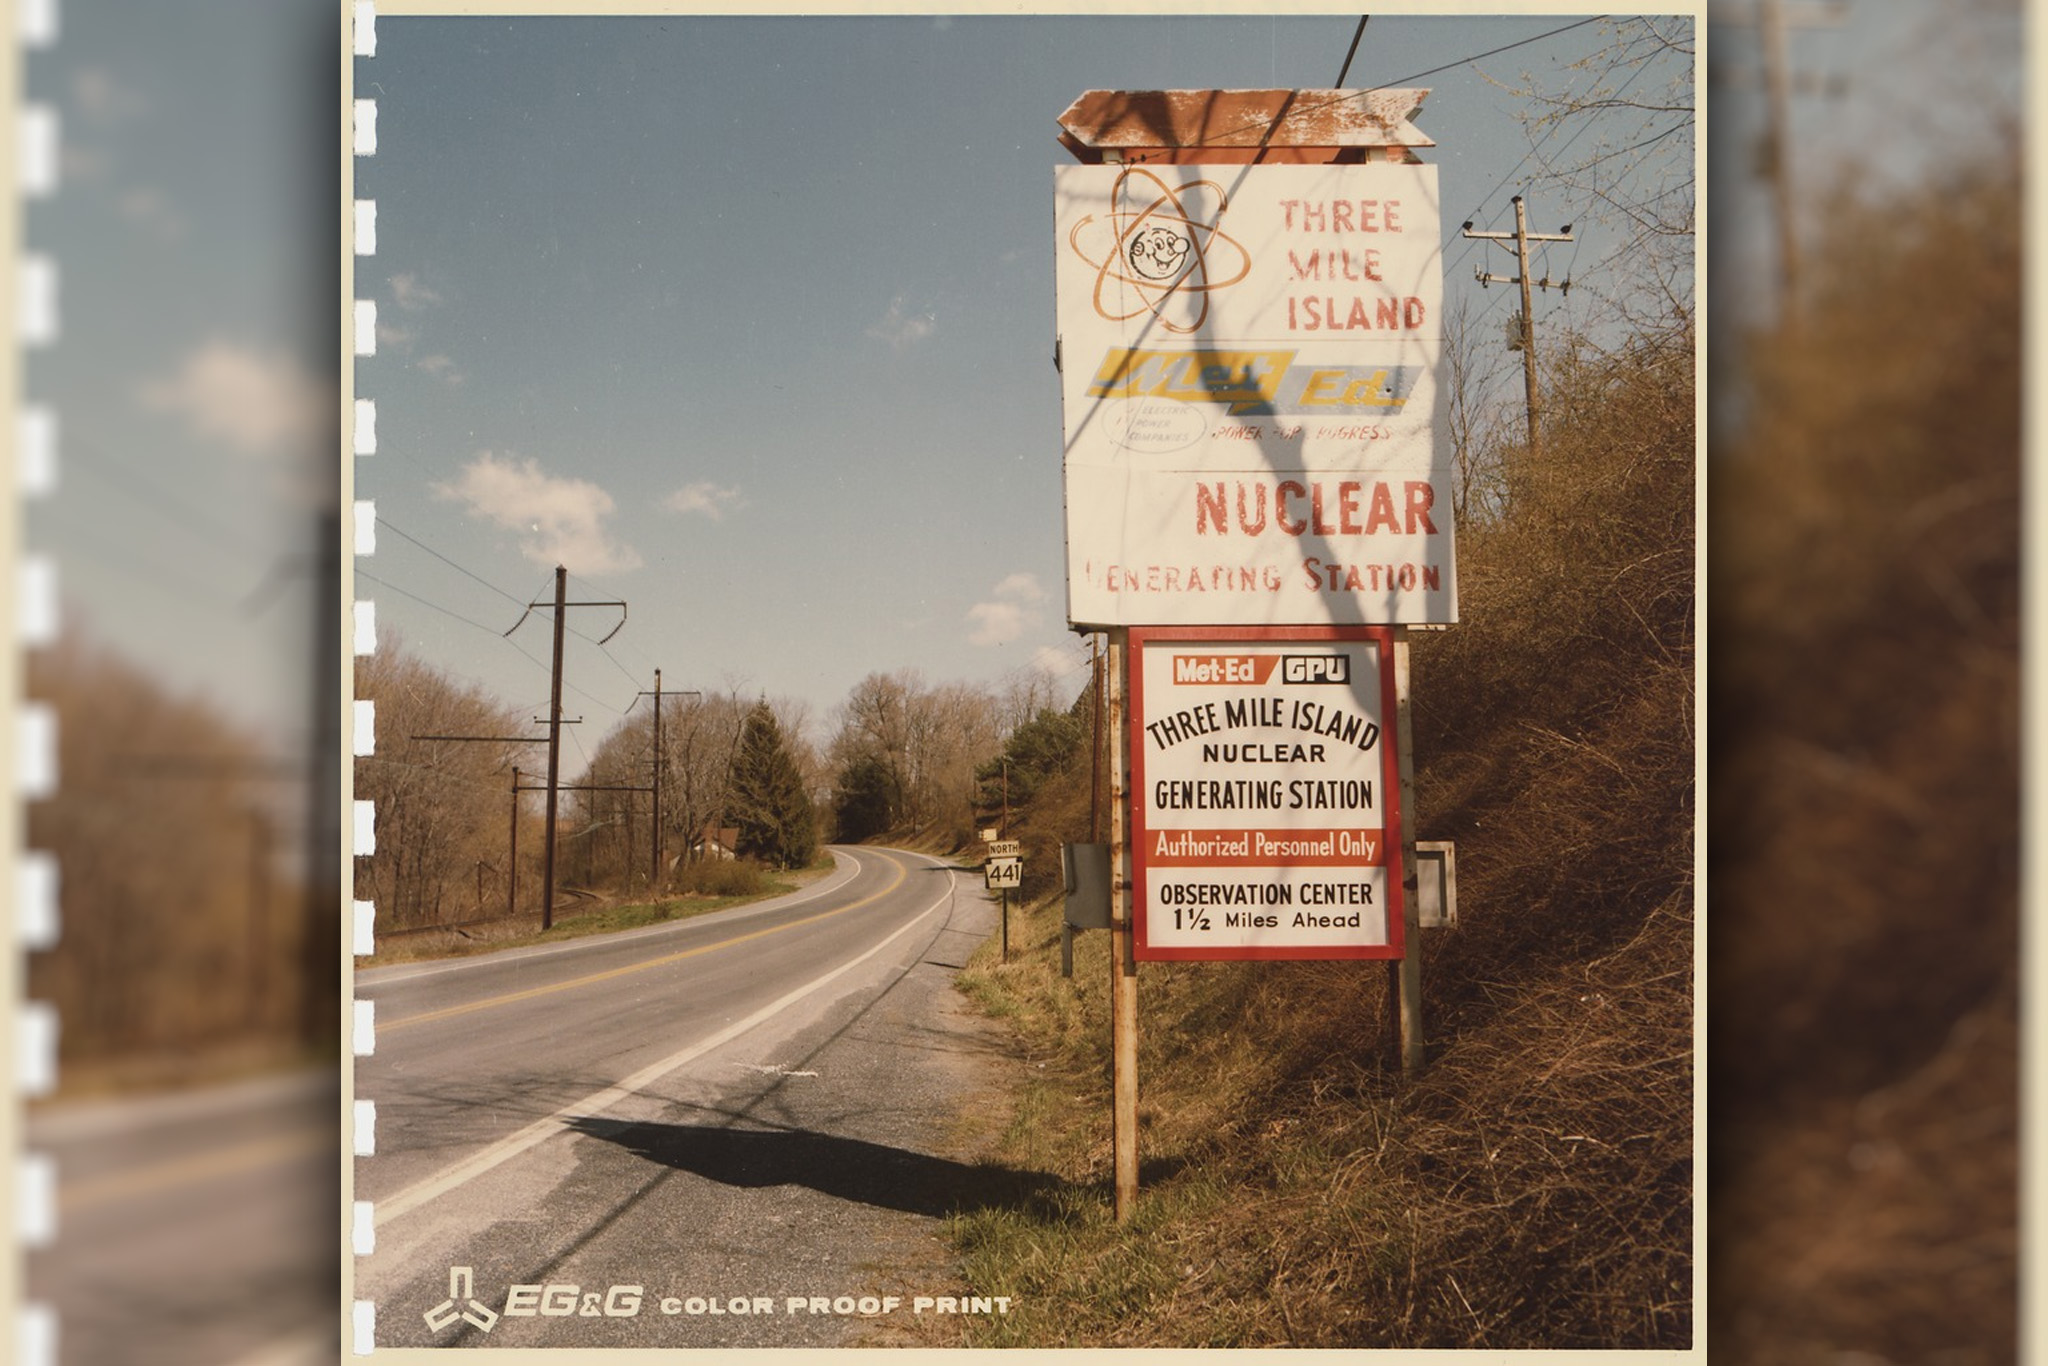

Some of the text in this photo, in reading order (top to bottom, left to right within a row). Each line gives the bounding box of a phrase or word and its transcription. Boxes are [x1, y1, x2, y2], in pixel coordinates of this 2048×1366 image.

[1279, 199, 1403, 233] THREE
[1288, 248, 1383, 282] MILE
[1288, 296, 1425, 330] ISLAND
[1196, 480, 1438, 536] NUCLEAR
[1085, 557, 1440, 593] ENERATING STATION
[1176, 658, 1346, 682] Met-Ed GPU
[1146, 698, 1379, 751] THREE MILE ISLAND
[1203, 744, 1326, 763] NUCLEAR
[1155, 780, 1372, 809] GENERATING STATION
[990, 844, 1018, 854] NORTH
[1155, 830, 1376, 861] Authorized Personnel Only
[989, 864, 1019, 882] 441
[1161, 883, 1373, 905] OBSERVATION CENTER
[1226, 912, 1278, 928] Miles
[1292, 912, 1360, 928] Ahead
